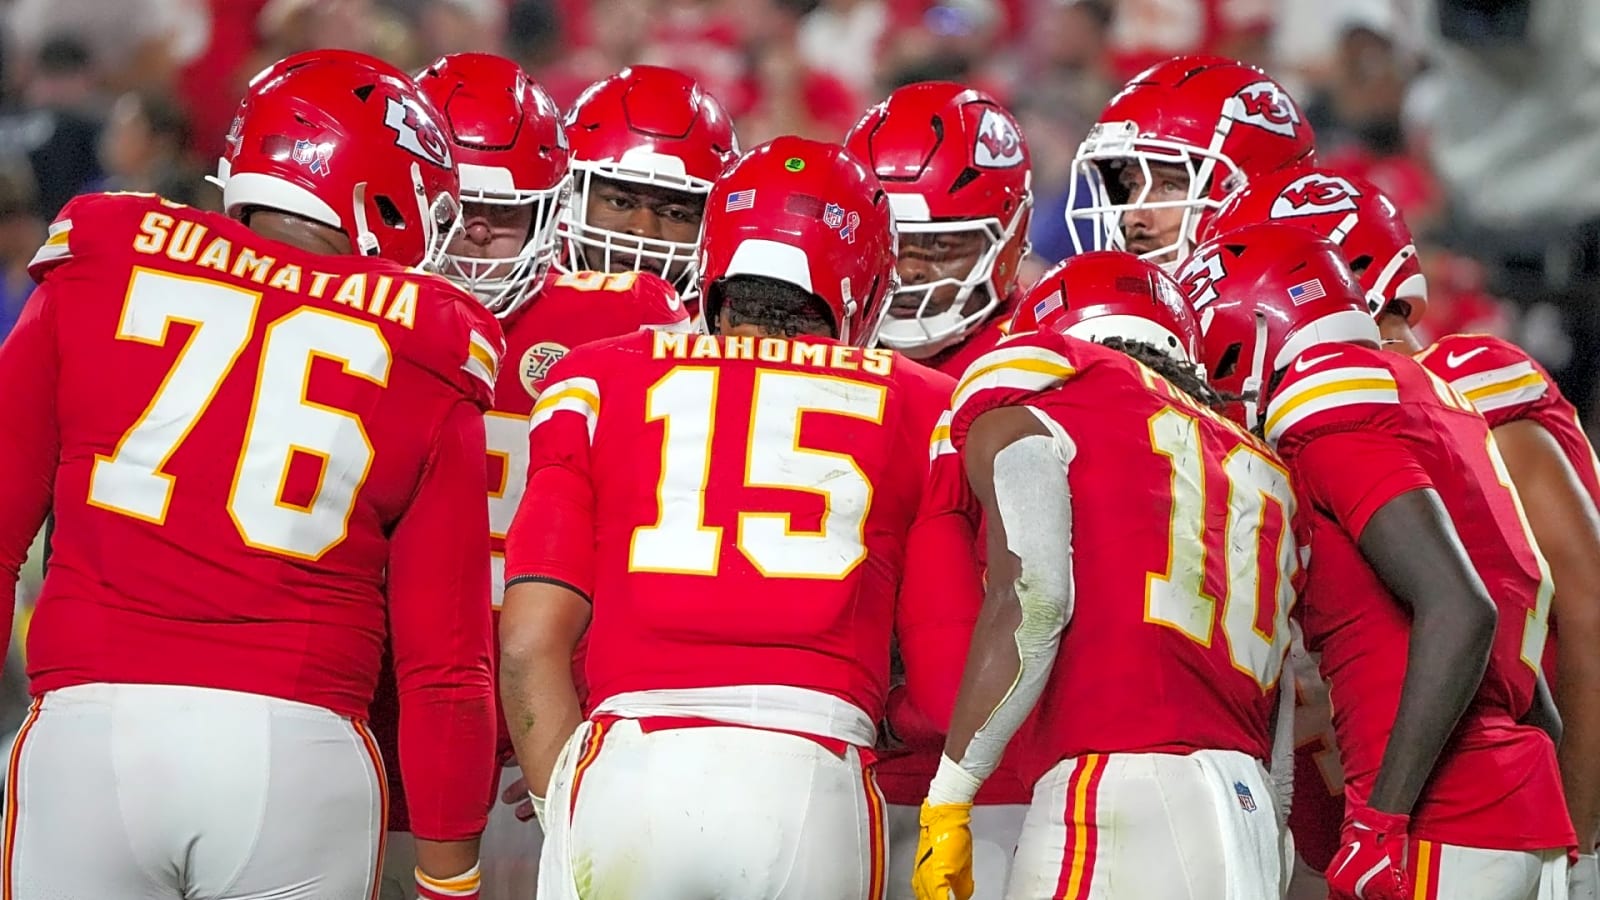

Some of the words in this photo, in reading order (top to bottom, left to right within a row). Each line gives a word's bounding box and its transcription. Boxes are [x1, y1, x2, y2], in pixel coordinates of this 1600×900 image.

[132, 211, 419, 330] SUAMATAIA
[1280, 179, 1350, 210] KC
[88, 265, 392, 561] 76
[652, 331, 894, 376] MAHOMES
[629, 365, 885, 579] 15
[1144, 404, 1299, 696] 10
